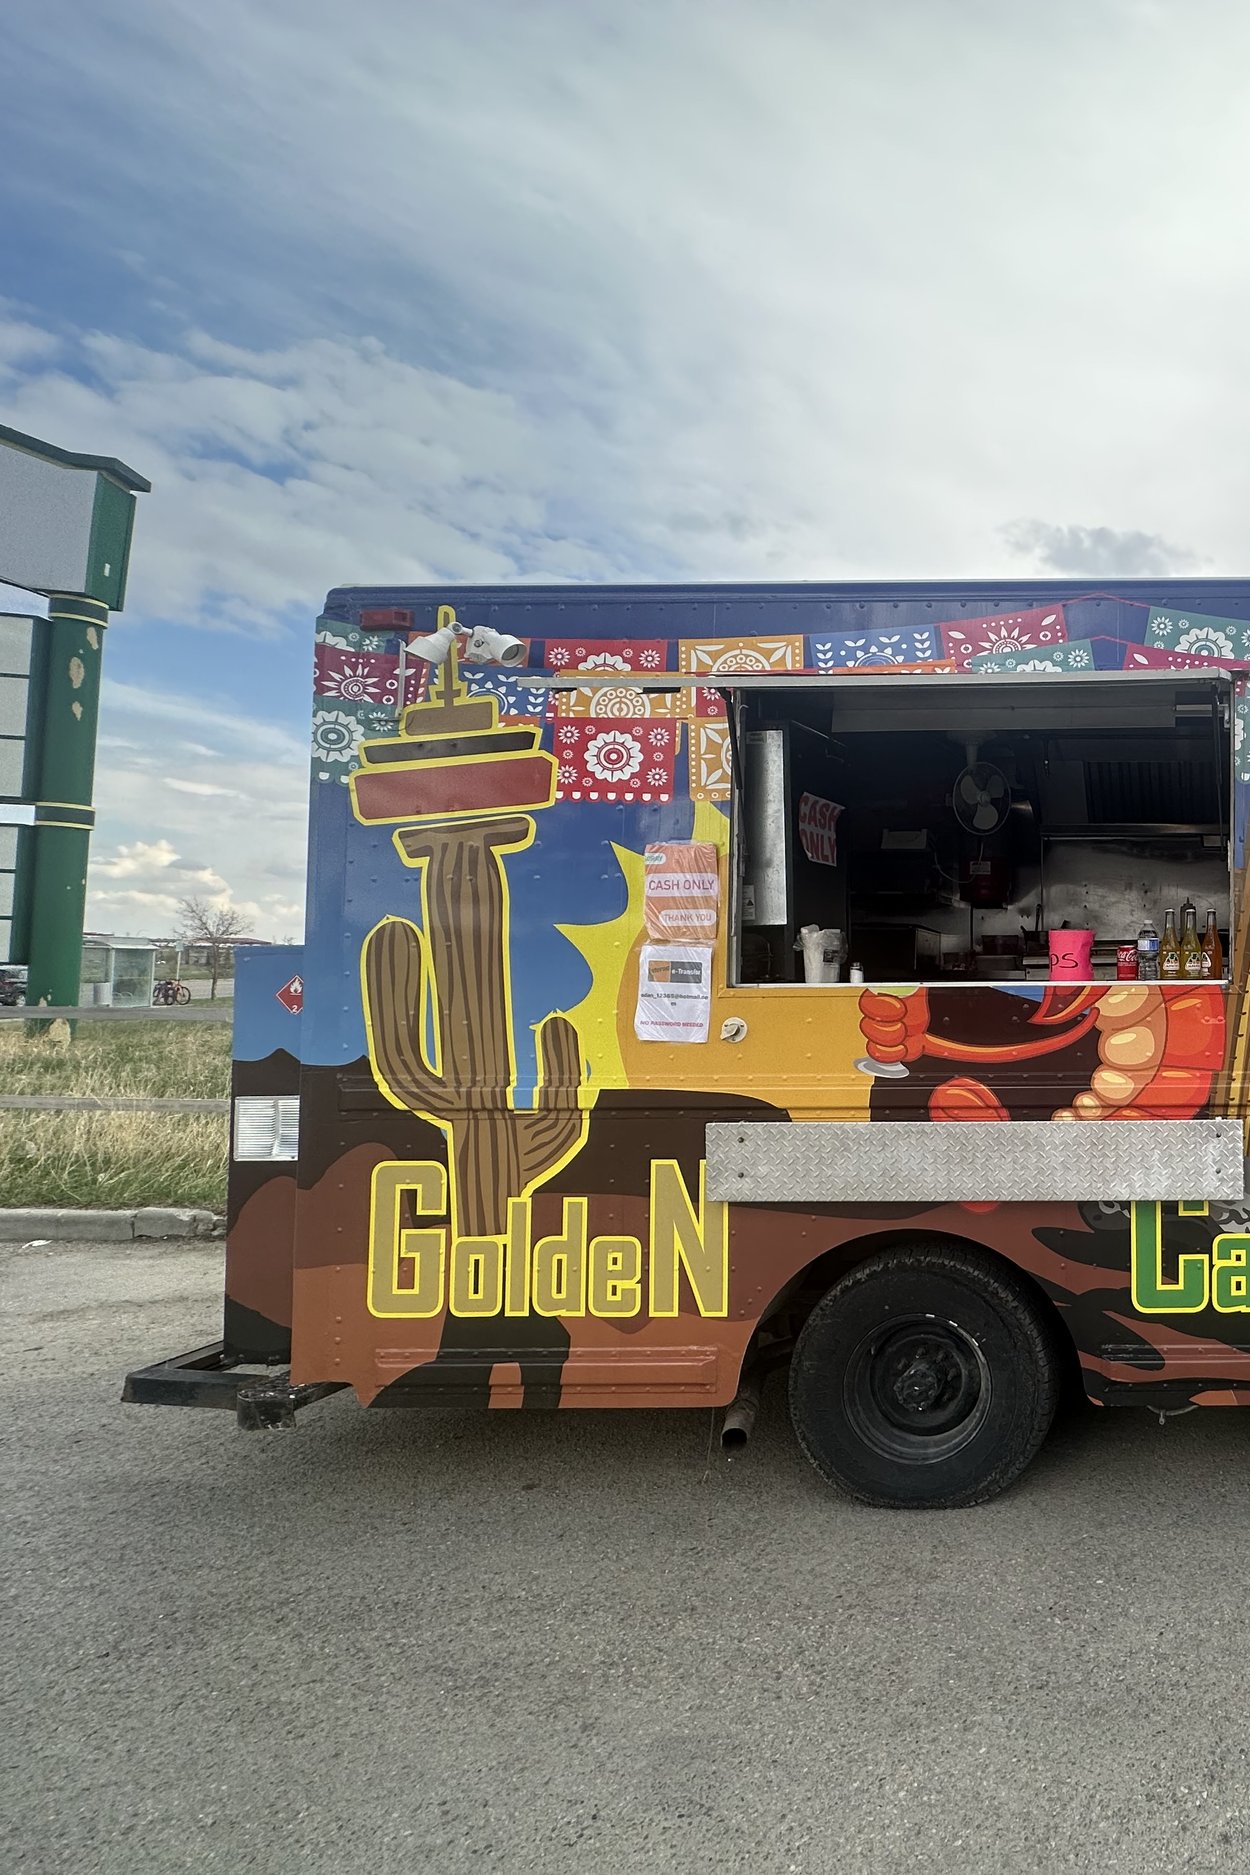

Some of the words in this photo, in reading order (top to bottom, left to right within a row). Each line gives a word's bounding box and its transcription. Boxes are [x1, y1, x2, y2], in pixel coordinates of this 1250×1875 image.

[799, 795, 841, 832] CASH
[800, 828, 837, 864] ONLY
[648, 880, 680, 891] CASH
[683, 880, 714, 890] ONLY
[664, 913, 693, 922] THANK
[695, 913, 712, 921] YOU
[366, 1158, 730, 1319] GoldeN
